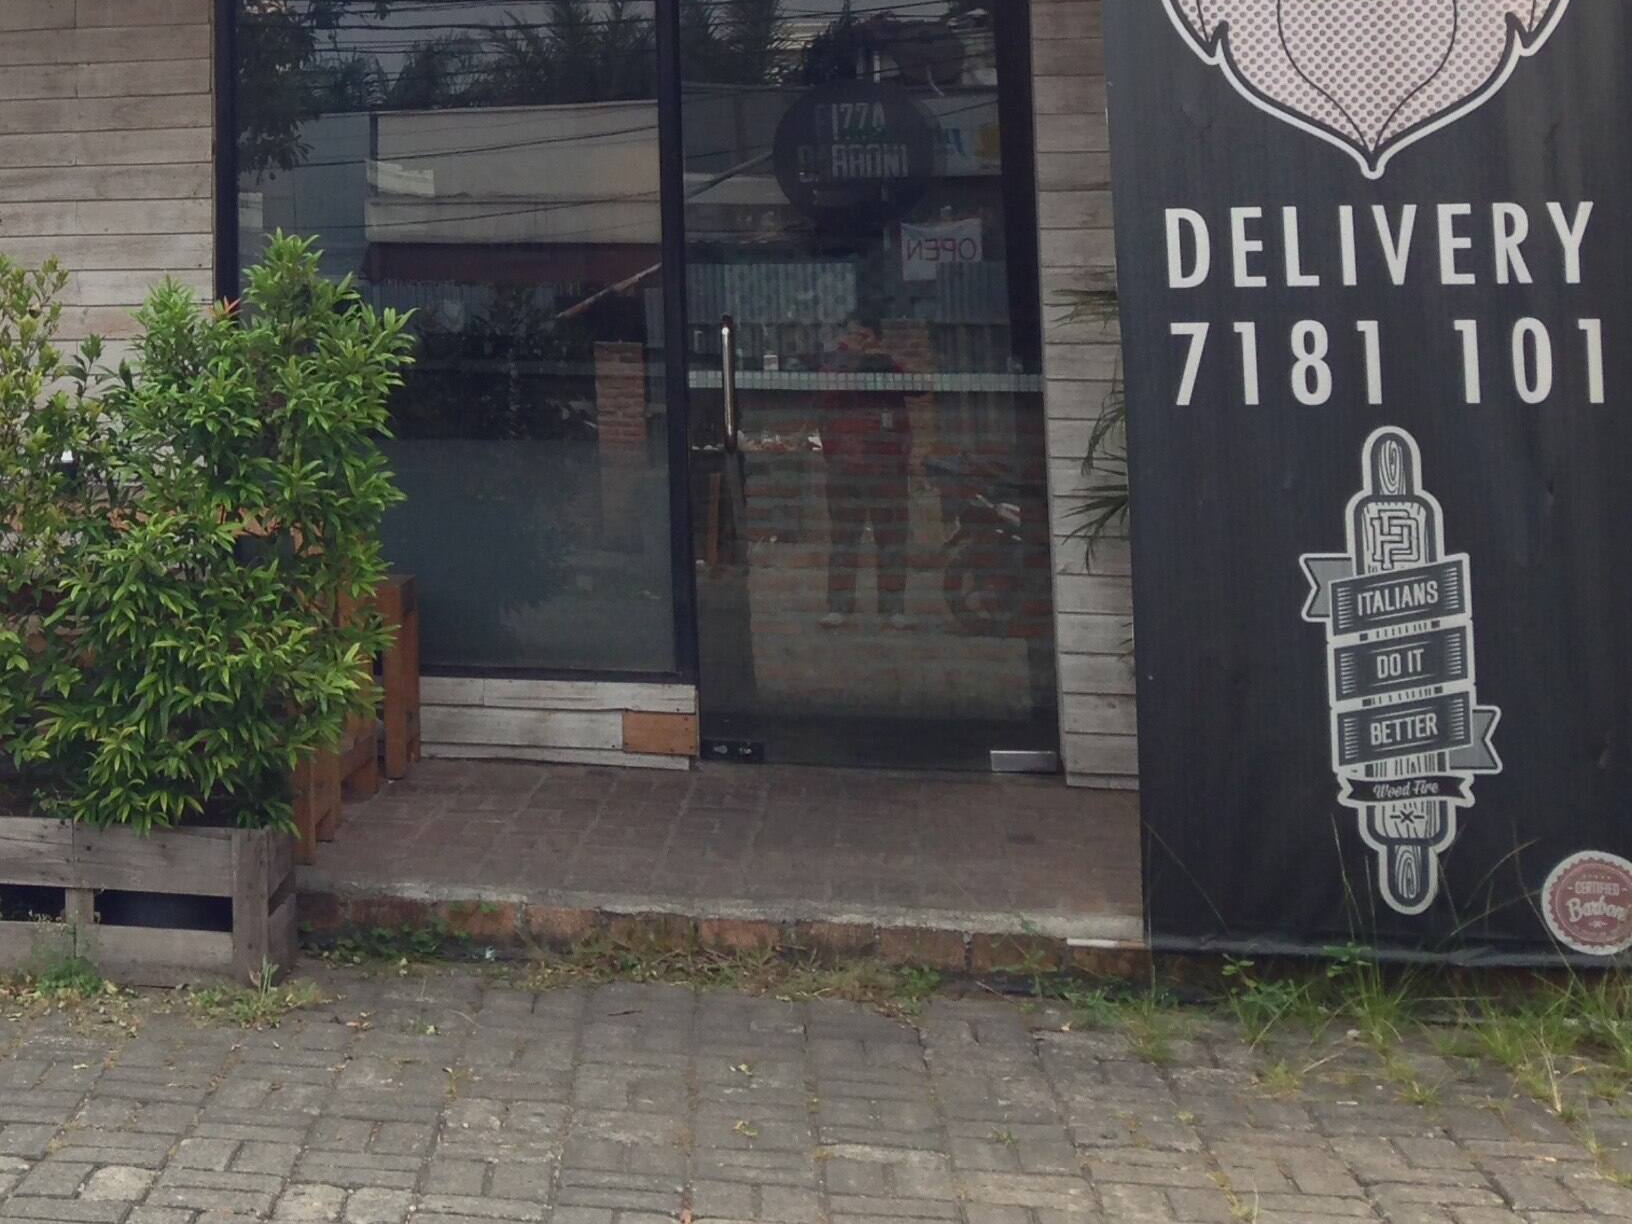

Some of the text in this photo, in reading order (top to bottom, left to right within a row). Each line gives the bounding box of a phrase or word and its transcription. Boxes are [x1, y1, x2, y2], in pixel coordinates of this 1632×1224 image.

[1164, 201, 1595, 289] DELIVERY
[1169, 316, 1605, 406] 7181 101
[1357, 580, 1439, 617] ITALIANS
[1376, 648, 1425, 679] DO IT
[1369, 711, 1439, 745] BETTER
